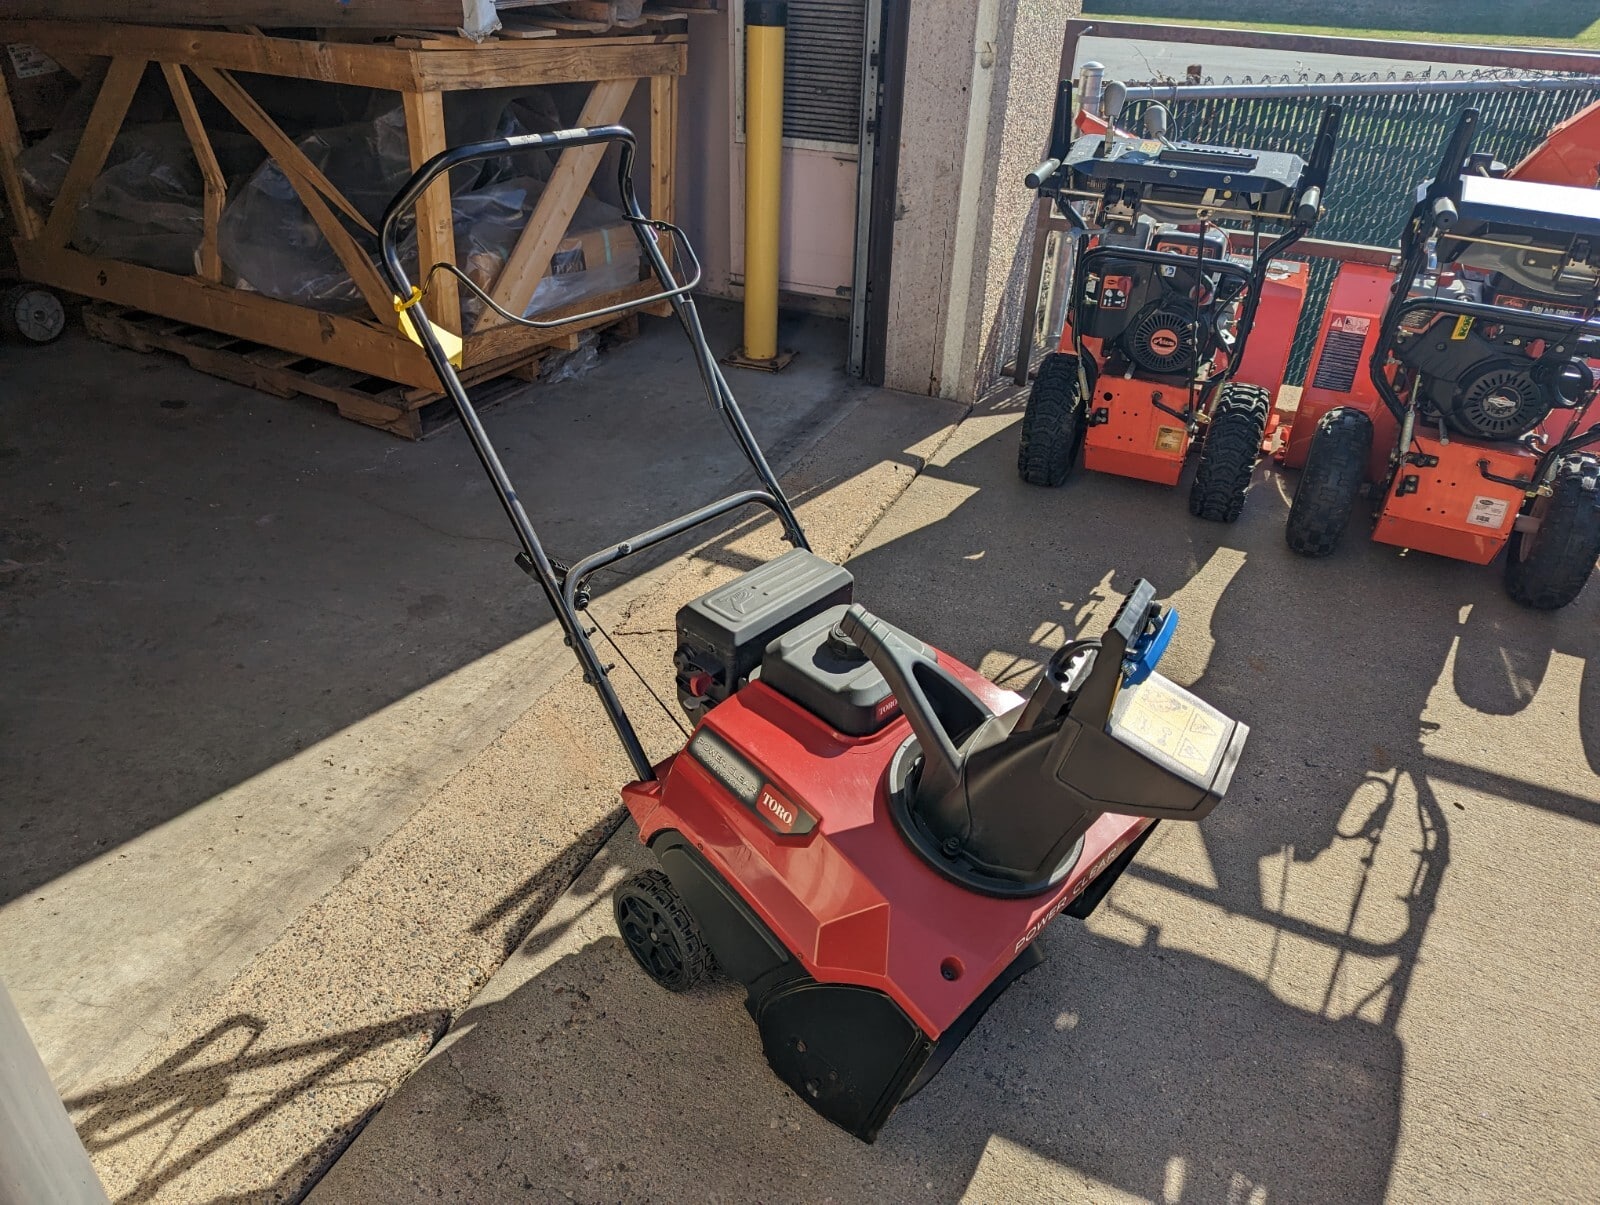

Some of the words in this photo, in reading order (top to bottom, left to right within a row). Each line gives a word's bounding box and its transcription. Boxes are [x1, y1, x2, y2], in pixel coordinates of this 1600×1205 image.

[879, 699, 898, 715] TORO
[696, 737, 728, 769] POWER
[763, 792, 793, 825] TORO
[1015, 896, 1067, 954] POWER
[1072, 847, 1117, 895] CLEAR
